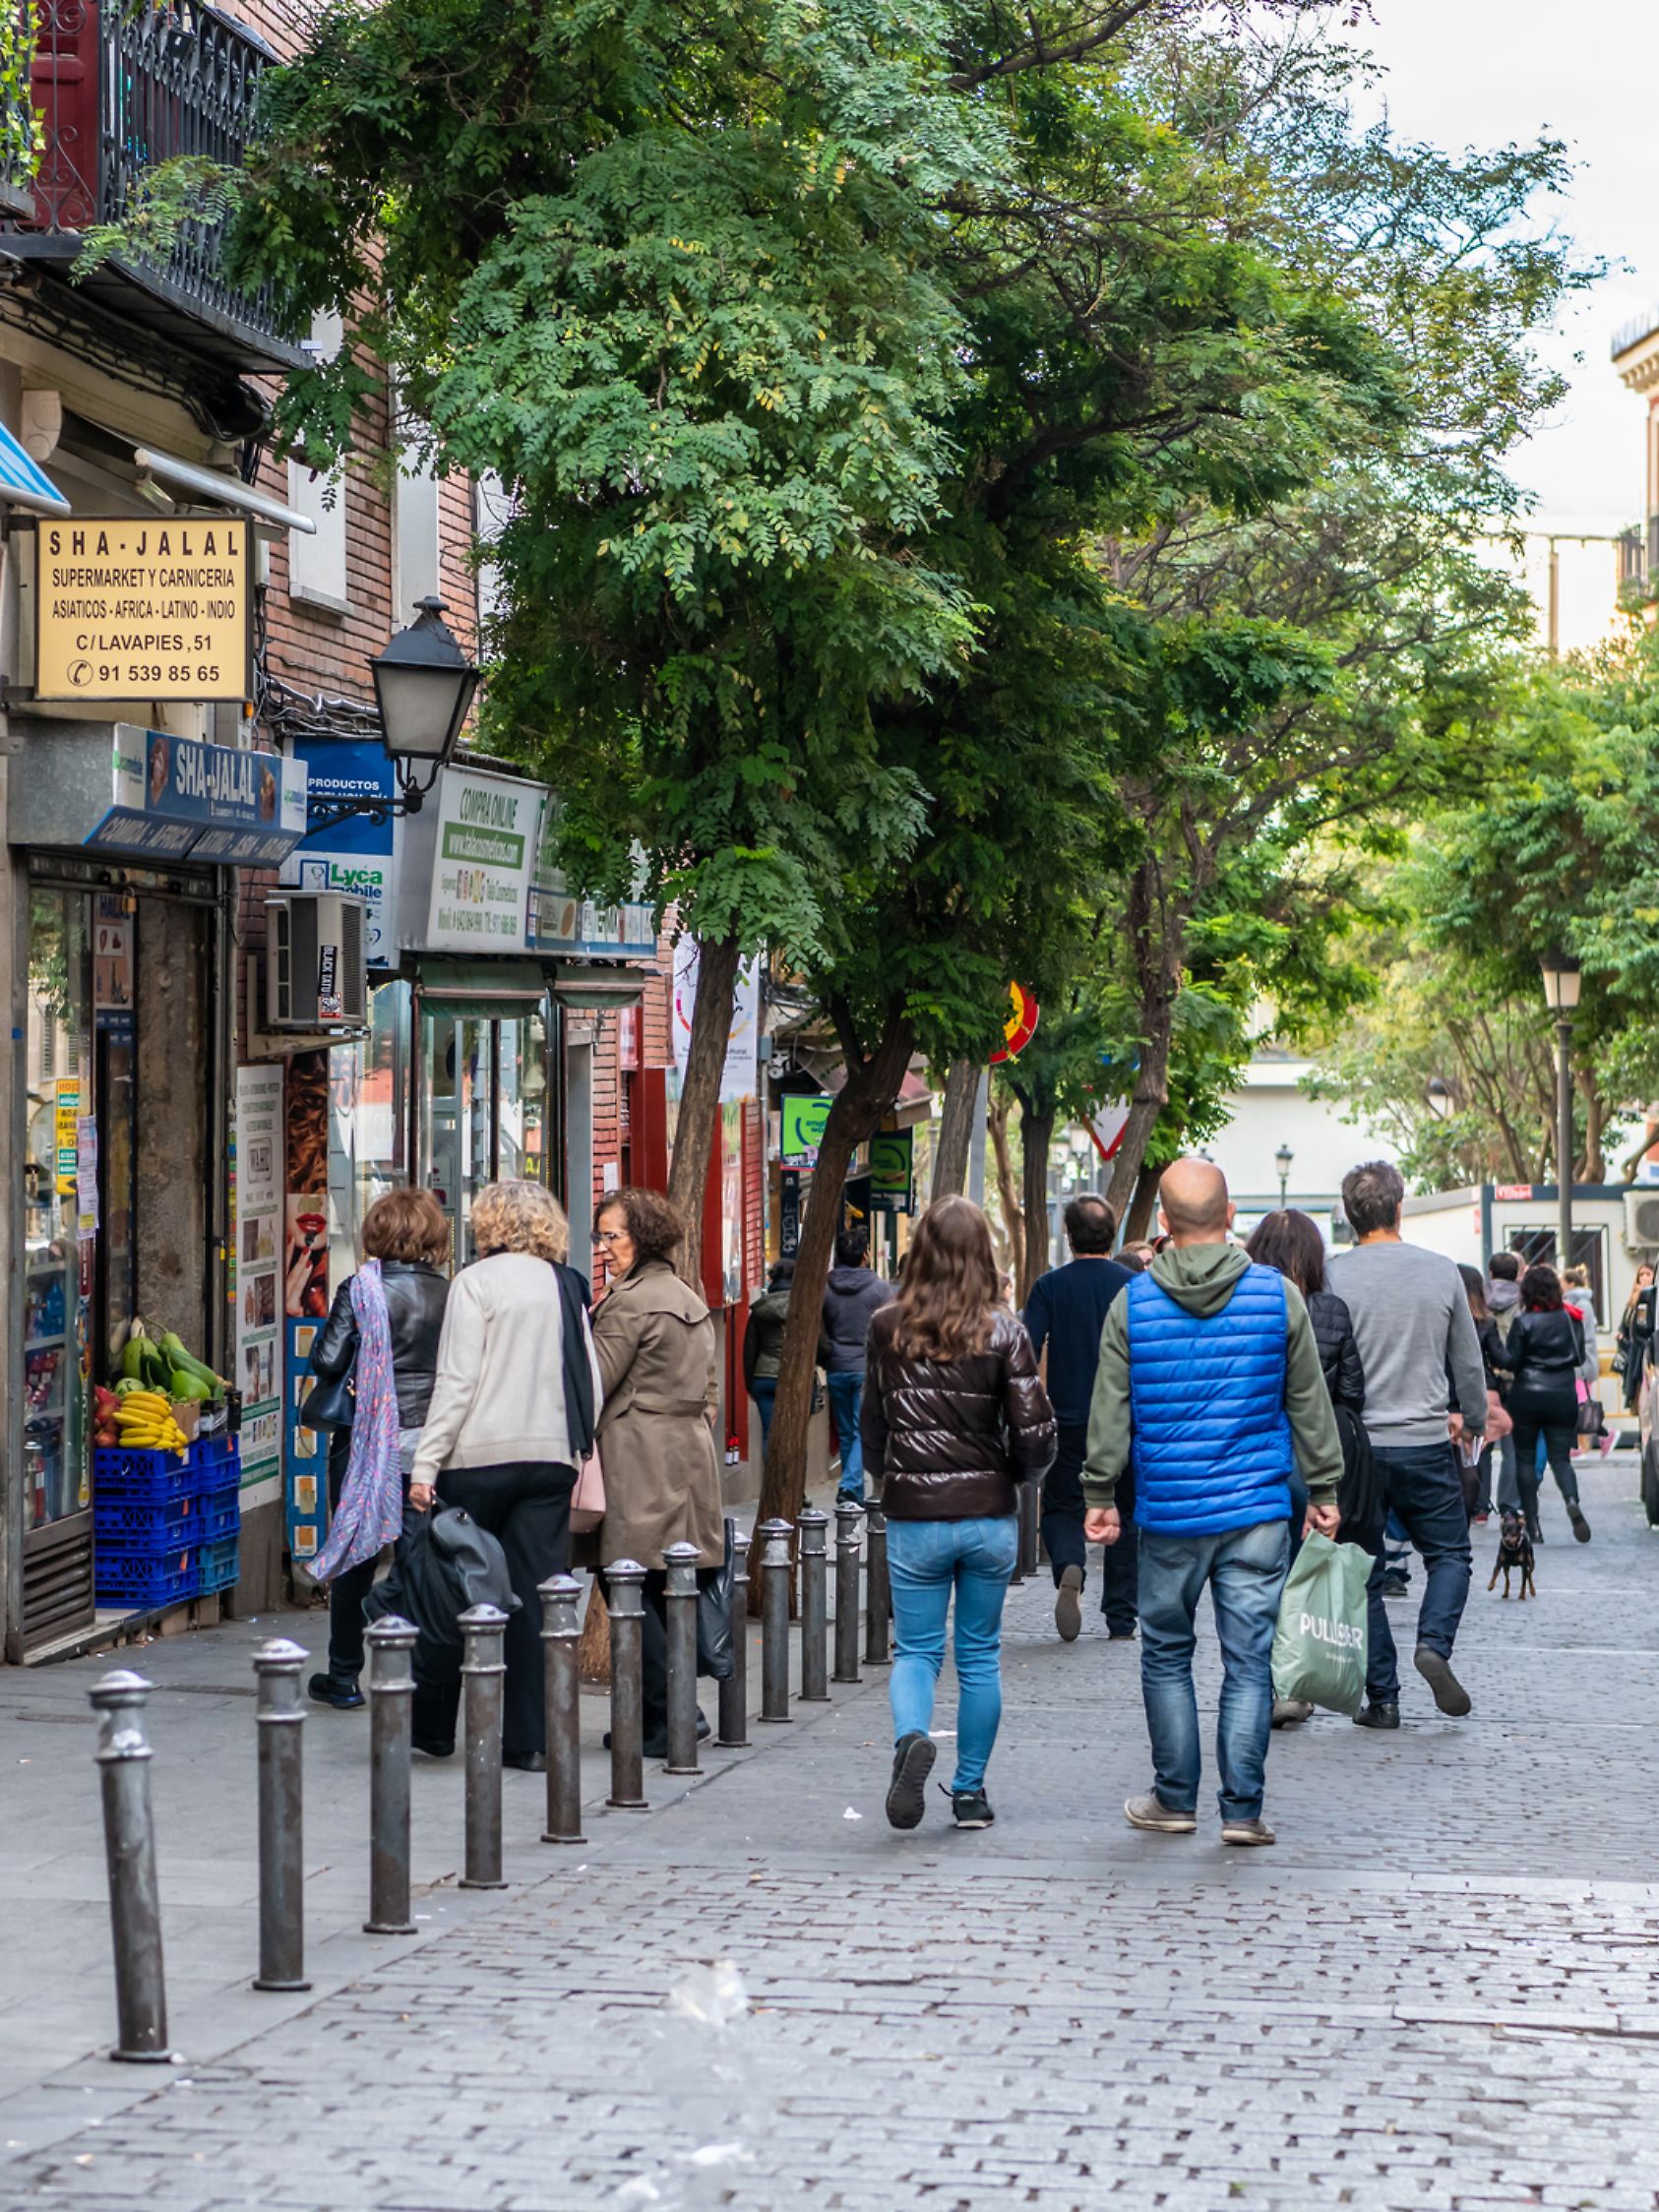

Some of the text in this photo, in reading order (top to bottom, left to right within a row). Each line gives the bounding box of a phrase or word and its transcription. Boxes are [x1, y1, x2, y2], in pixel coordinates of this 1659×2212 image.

[52, 568, 235, 587] SUPERMARKET Y CARNICERIA
[52, 599, 107, 619] ASIATICOS
[115, 599, 153, 619] AFRICA
[161, 599, 198, 619] LATINO
[207, 599, 235, 619] INDIO
[99, 665, 220, 681] 91 539 85 65
[176, 743, 256, 806] SHA-JALAL
[308, 777, 380, 791] PRODUCTOS
[460, 787, 519, 830] COMPRA ONLINE
[331, 864, 383, 886] Lyca
